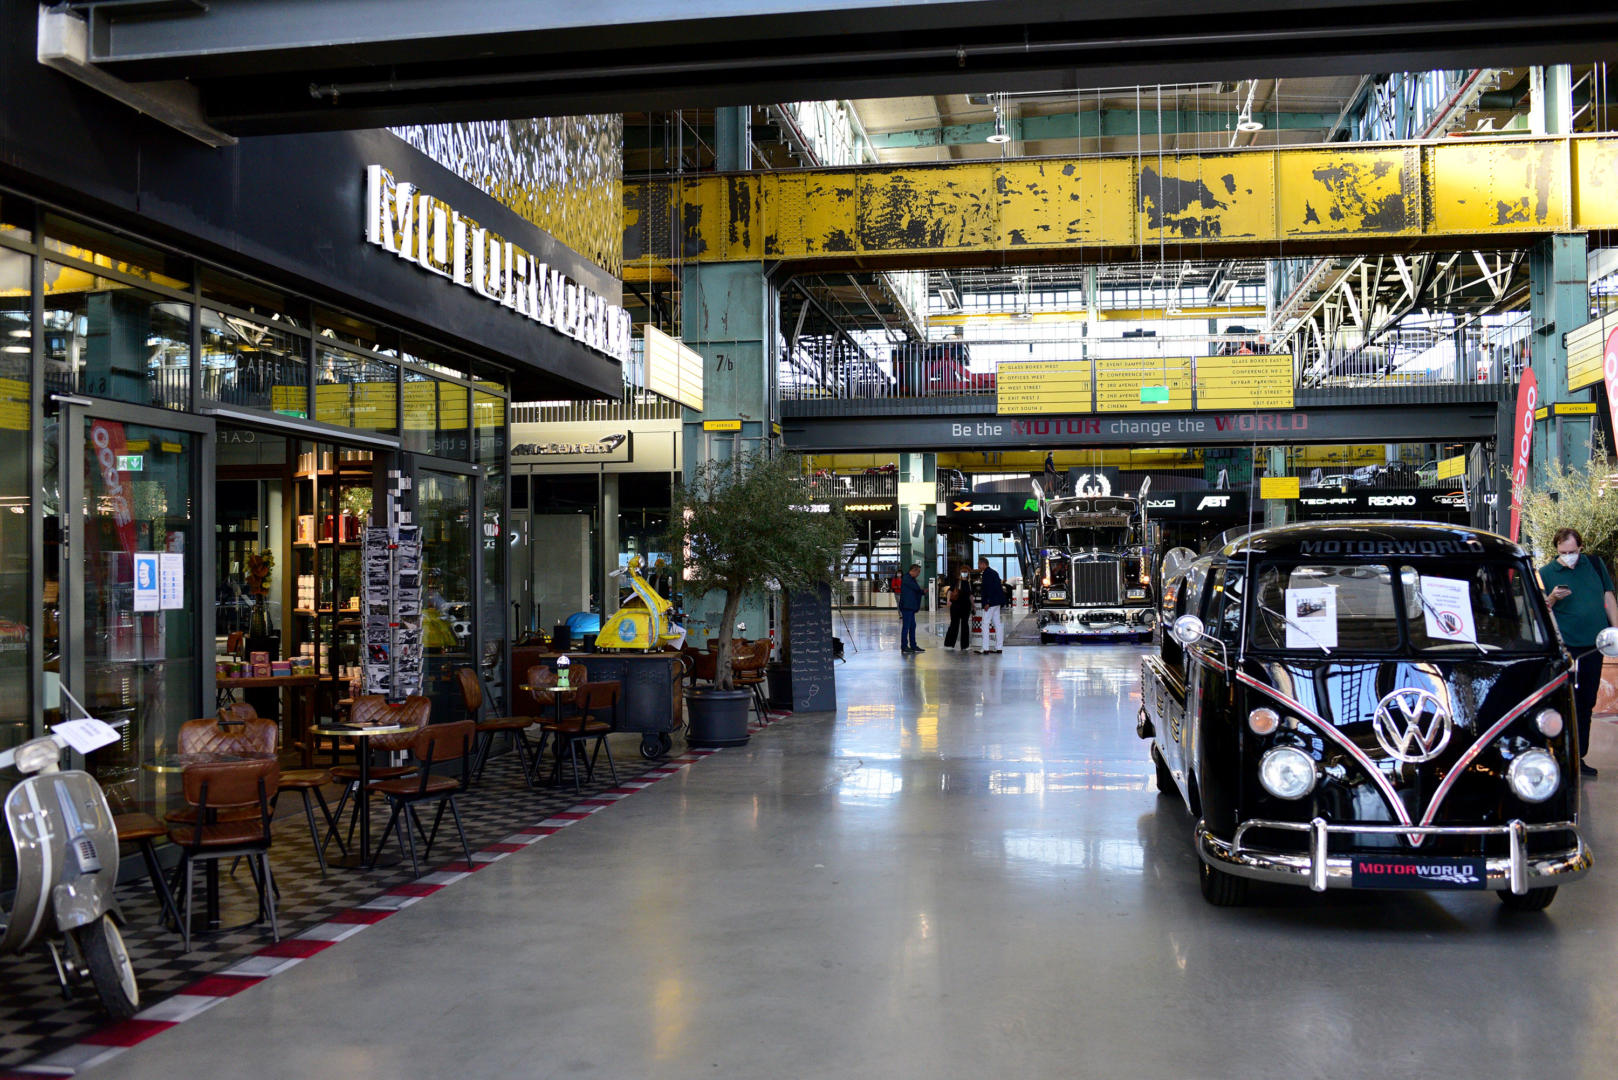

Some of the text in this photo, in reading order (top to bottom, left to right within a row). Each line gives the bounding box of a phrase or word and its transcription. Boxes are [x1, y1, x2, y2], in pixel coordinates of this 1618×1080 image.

[952, 413, 1309, 437] Be the MOTOR change the WORLD
[953, 501, 1001, 512] X-BOW
[1146, 499, 1176, 508] NVO
[1197, 496, 1231, 511] ABT
[1368, 495, 1416, 506] RECARO
[845, 503, 893, 512] MANHART
[1300, 538, 1486, 554] MOTORWORLD
[1359, 862, 1474, 876] MOTORWORLD
